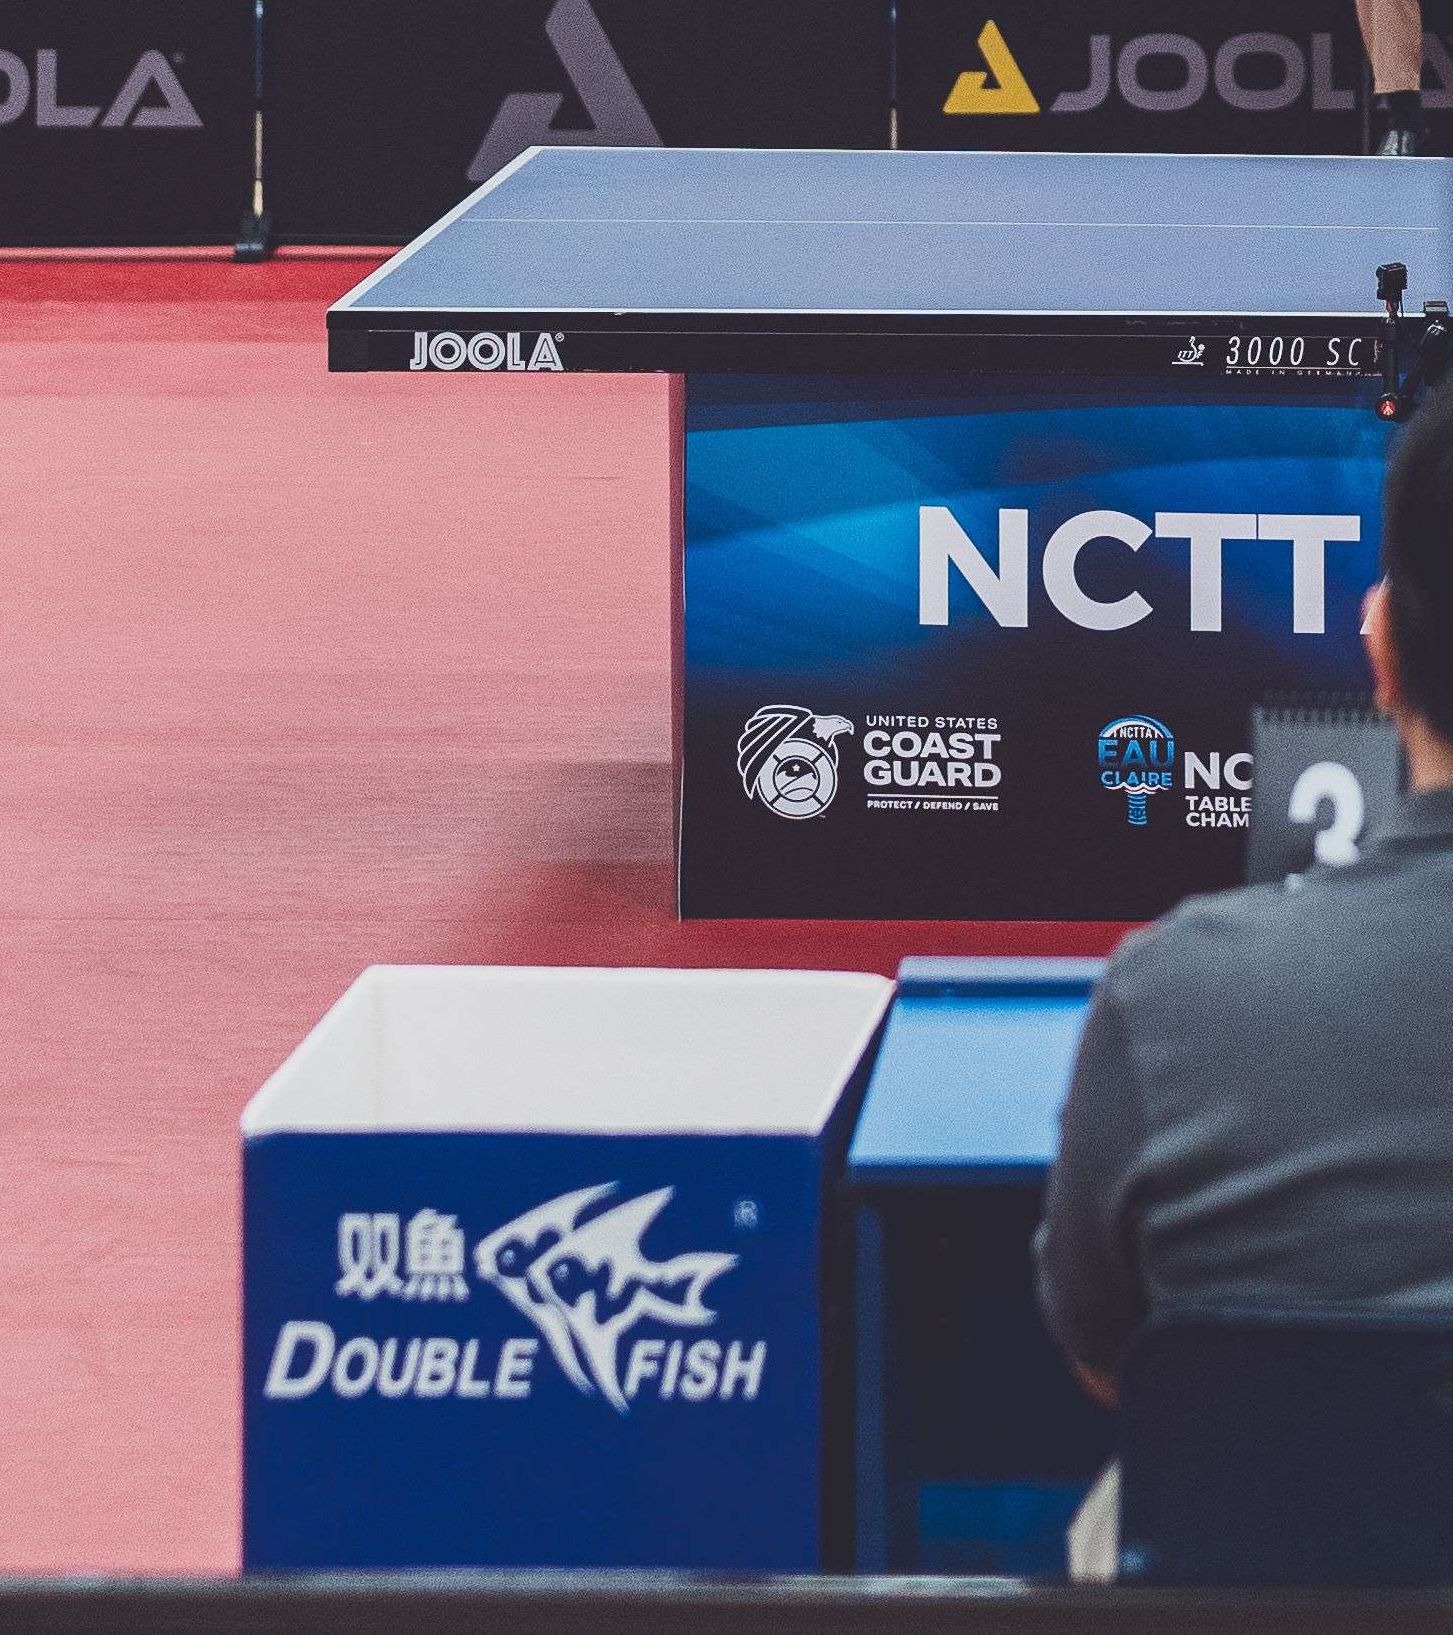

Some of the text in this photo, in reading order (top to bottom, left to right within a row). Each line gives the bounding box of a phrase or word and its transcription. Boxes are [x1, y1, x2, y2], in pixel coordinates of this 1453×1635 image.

[409, 331, 564, 370] JOOLA
[1226, 336, 1362, 365] 3000 SC
[919, 505, 1362, 634] NCTT
[866, 716, 998, 729] UNITED STATES
[863, 730, 1001, 759] COAST
[1098, 739, 1175, 767] EAU
[863, 760, 1001, 787] GUARD
[1101, 770, 1173, 787] CLAIRE
[1184, 752, 1254, 790] NC
[867, 800, 913, 810] PROTECT
[923, 801, 963, 810] DEFEND
[972, 802, 999, 811] SAVE
[1185, 796, 1252, 812] TABLE
[1185, 813, 1250, 828] CHAM
[262, 1320, 767, 1401] DOUBLE FISH
